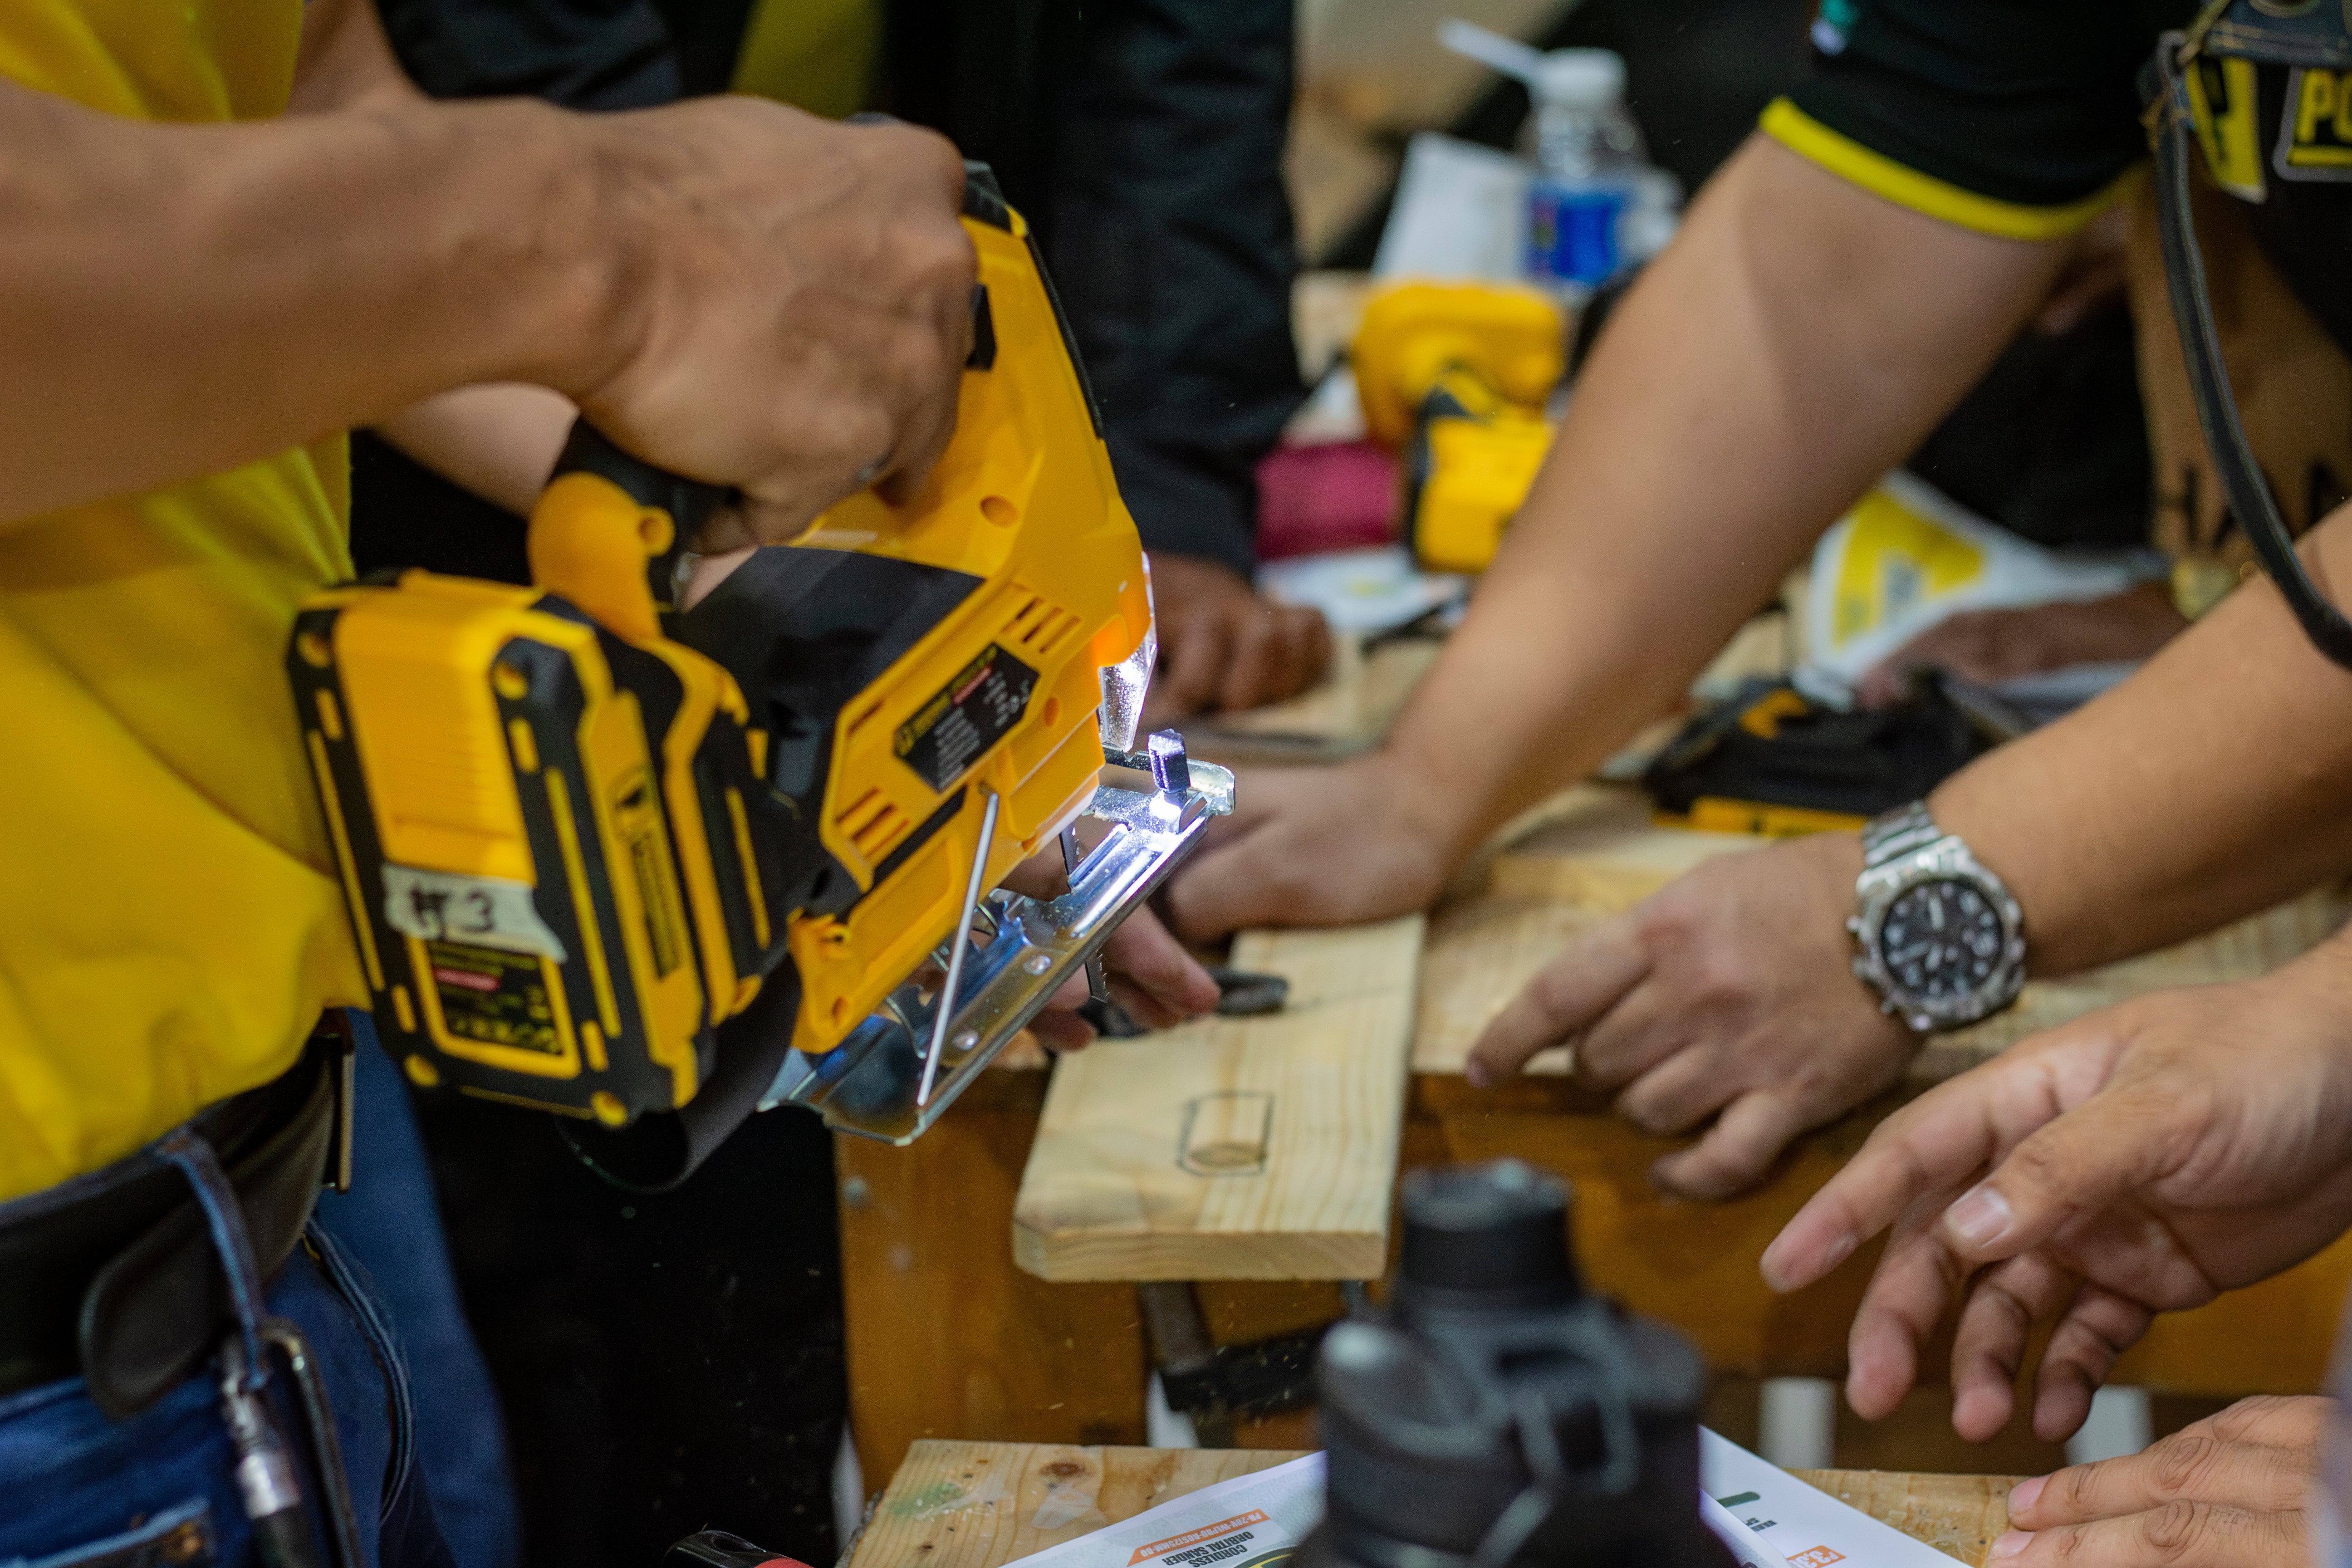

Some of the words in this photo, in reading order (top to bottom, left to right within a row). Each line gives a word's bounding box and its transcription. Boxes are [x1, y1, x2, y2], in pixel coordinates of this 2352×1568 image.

[1205, 1531, 1254, 1552] ORBITAL
[1161, 1546, 1209, 1566] SANDER
[1188, 1544, 1248, 1567] CORDLESS
